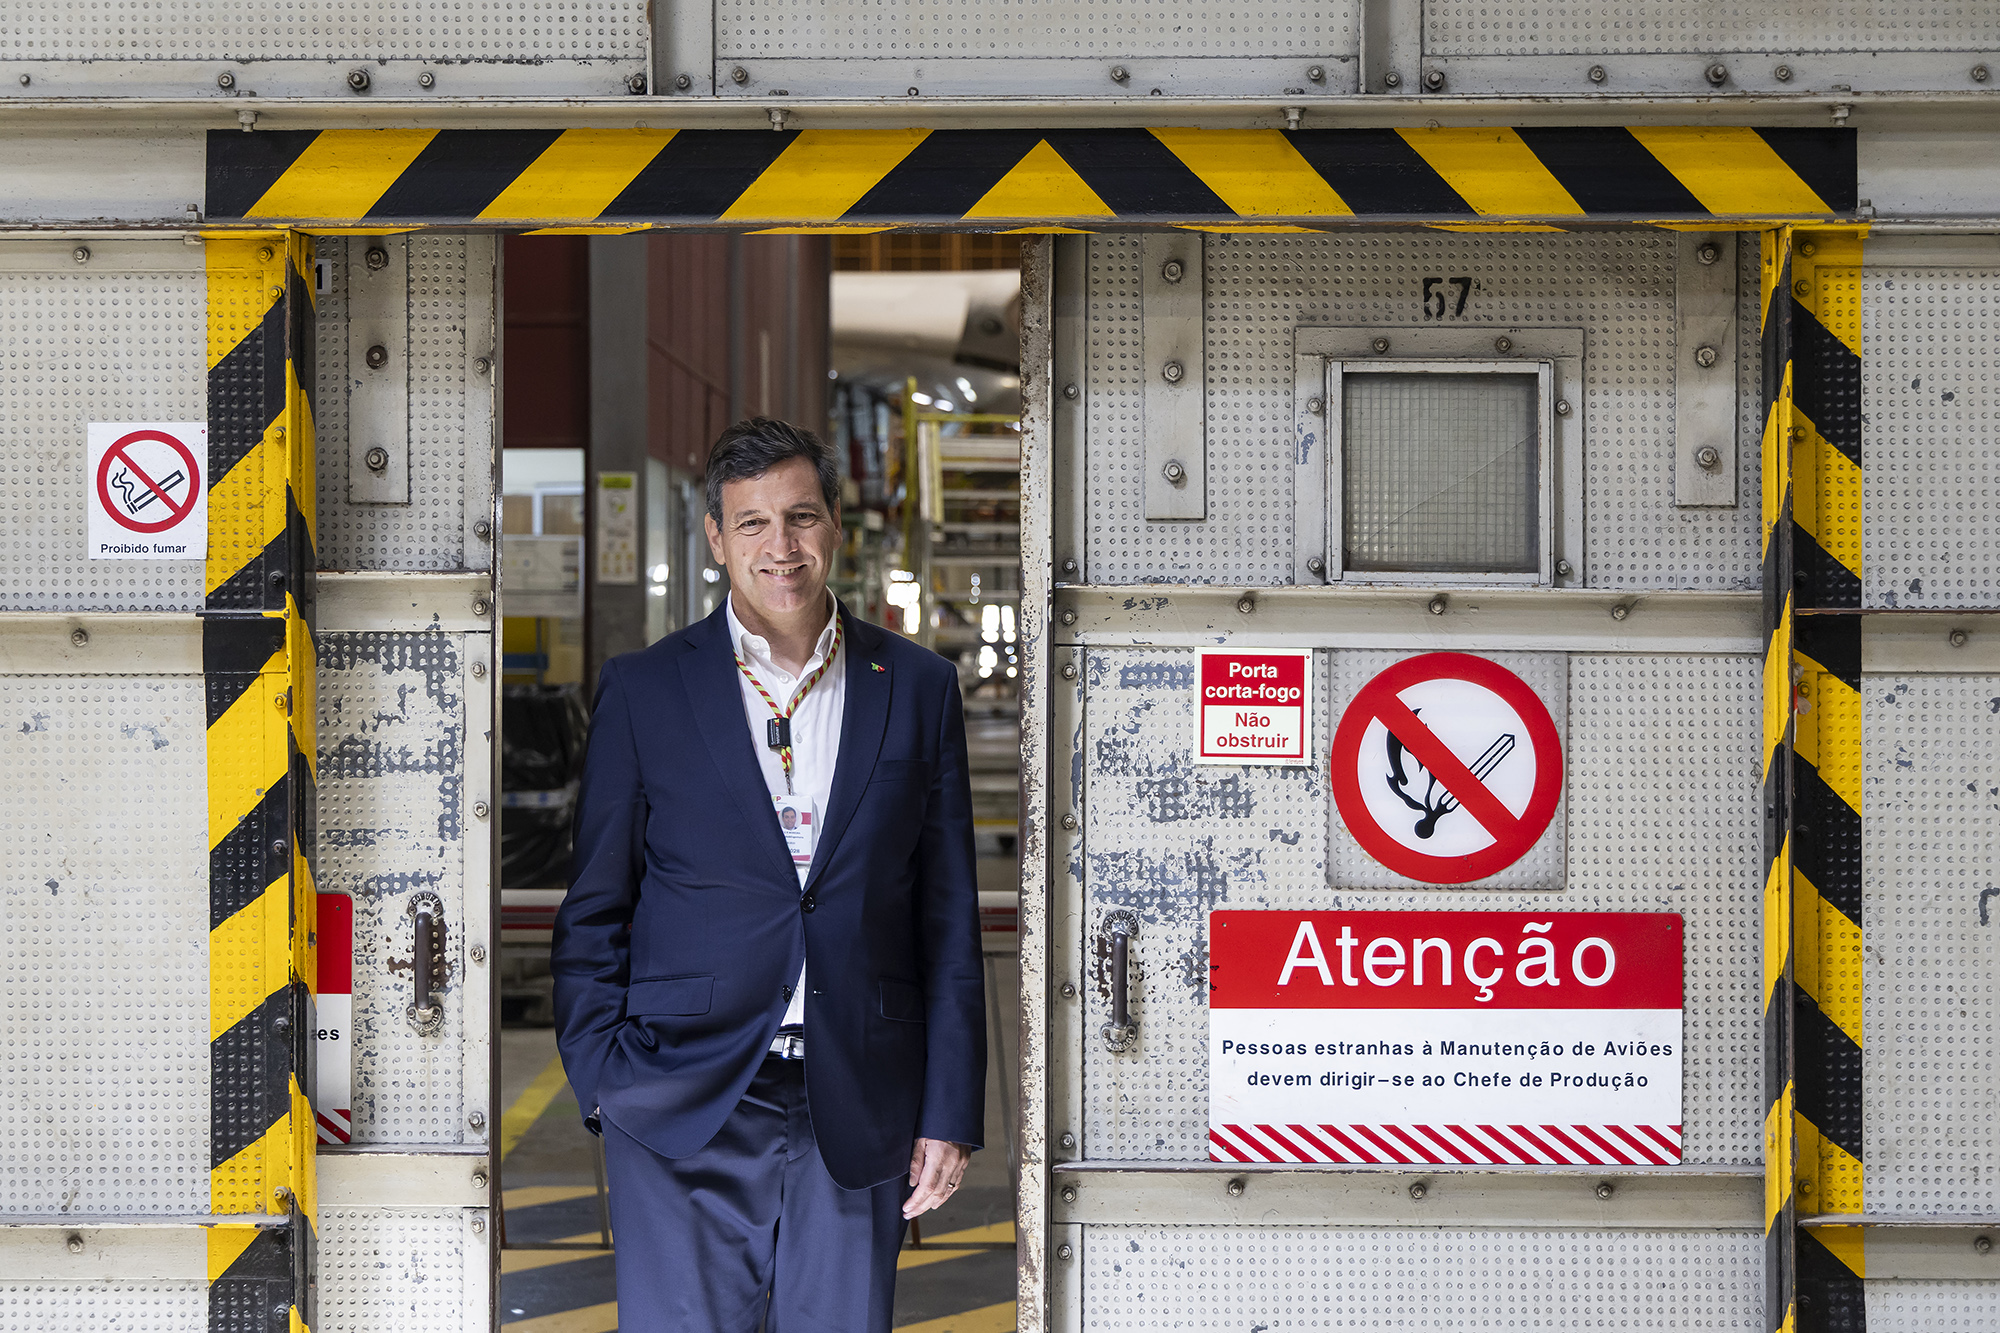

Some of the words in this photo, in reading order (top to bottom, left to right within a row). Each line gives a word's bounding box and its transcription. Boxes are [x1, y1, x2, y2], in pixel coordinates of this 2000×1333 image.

[1423, 276, 1472, 318] 57
[100, 543, 149, 554] Proibido
[153, 543, 187, 554] fumar
[1229, 662, 1278, 679] Porta
[1205, 683, 1301, 703] corta-fogo
[1235, 712, 1271, 728] Não
[1216, 732, 1289, 748] obstruir
[1277, 920, 1616, 1002] Atenção
[1222, 1039, 1307, 1056] Pessoas
[1314, 1040, 1414, 1056] estranhas
[1422, 1040, 1433, 1056] à
[1440, 1040, 1564, 1061] Manutenção
[1572, 1041, 1595, 1056] de
[1603, 1040, 1673, 1057] Aviões
[1247, 1071, 1312, 1087] devem
[1422, 1075, 1445, 1087] ao
[1453, 1071, 1512, 1087] Chefe
[1519, 1072, 1543, 1088] de
[1550, 1072, 1648, 1092] Produção
